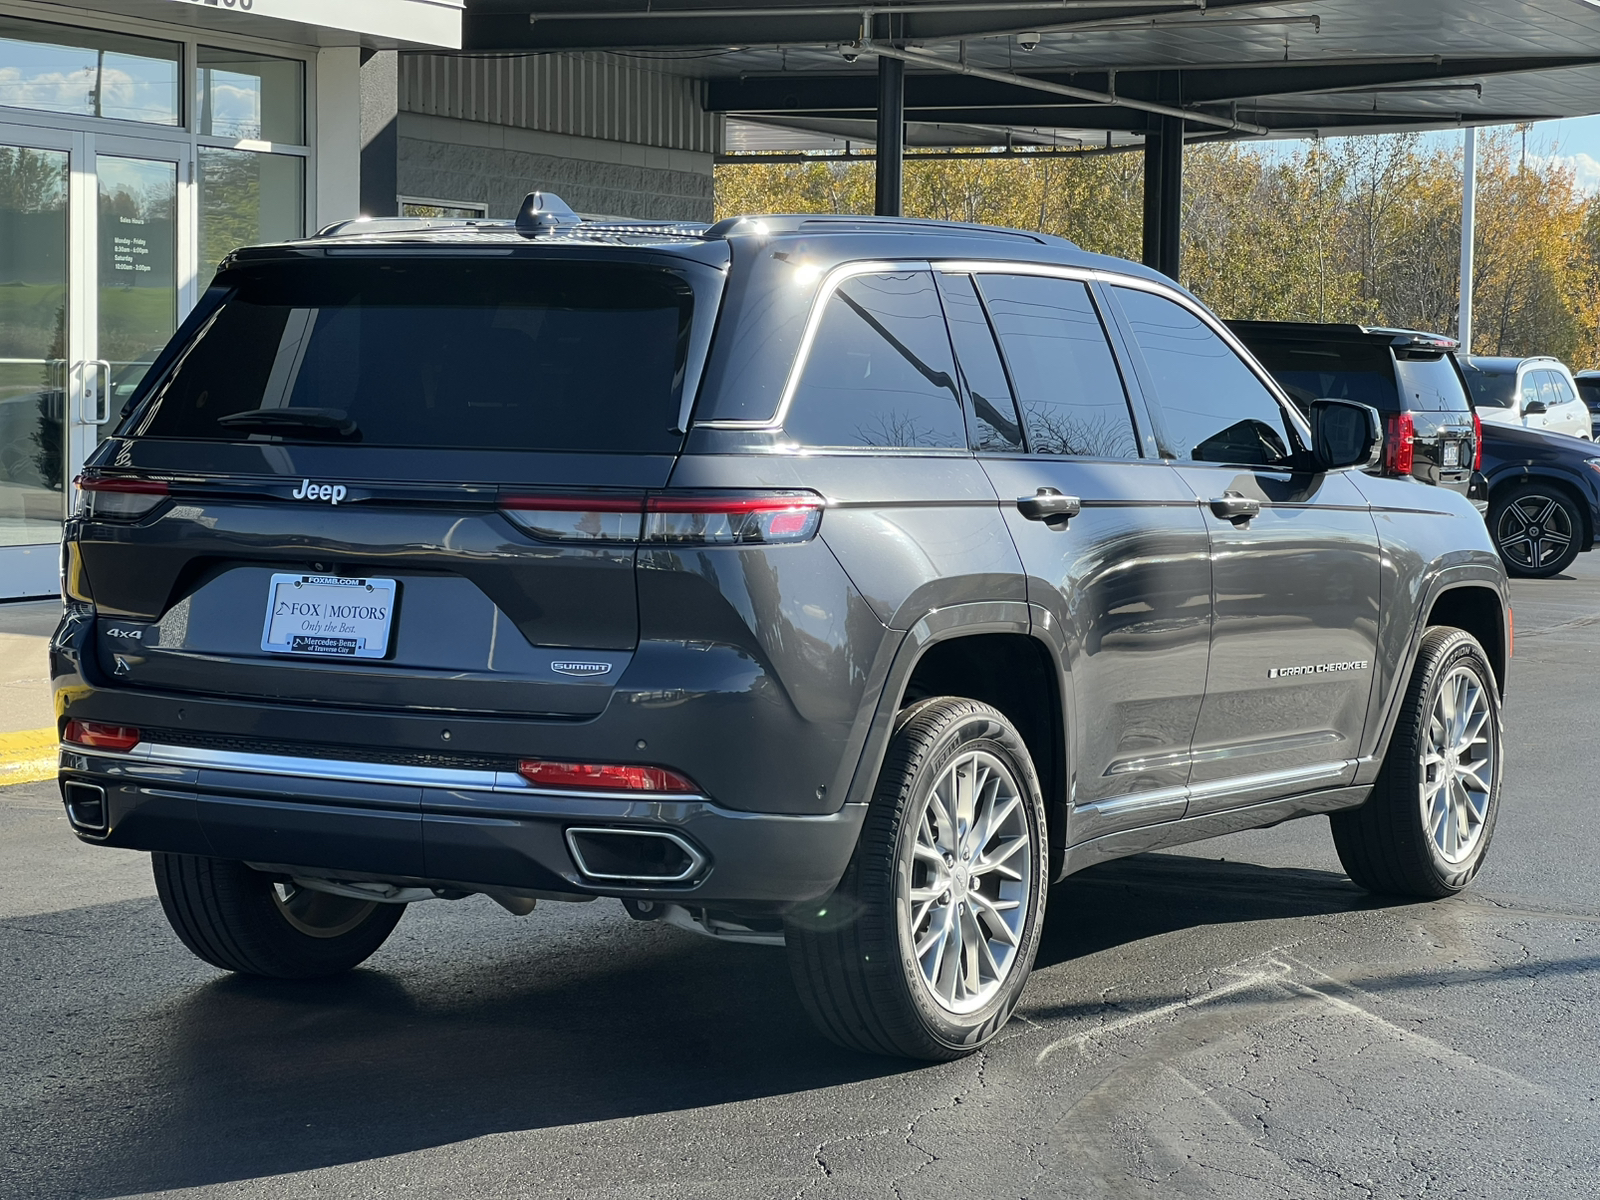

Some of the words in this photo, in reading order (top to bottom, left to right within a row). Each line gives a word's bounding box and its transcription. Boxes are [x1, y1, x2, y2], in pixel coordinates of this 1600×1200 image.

[131, 217, 144, 225] Hours
[114, 237, 130, 245] Monday
[133, 238, 146, 246] Friday
[114, 254, 133, 262] Saturday
[292, 479, 347, 505] Jeep
[308, 577, 359, 586] FOXMB.COM
[290, 602, 321, 616] FOX
[328, 605, 386, 620] MOTORS
[301, 620, 322, 634] Only
[323, 621, 337, 632] the
[338, 622, 356, 633] Best.
[106, 628, 142, 640] 4x4
[303, 637, 356, 648] Mercedes-Benz
[554, 663, 608, 671] SUMMIT
[1279, 665, 1315, 677] GRAND
[1315, 660, 1369, 673] CHEROKEE
[1033, 792, 1048, 915] SCORPION
